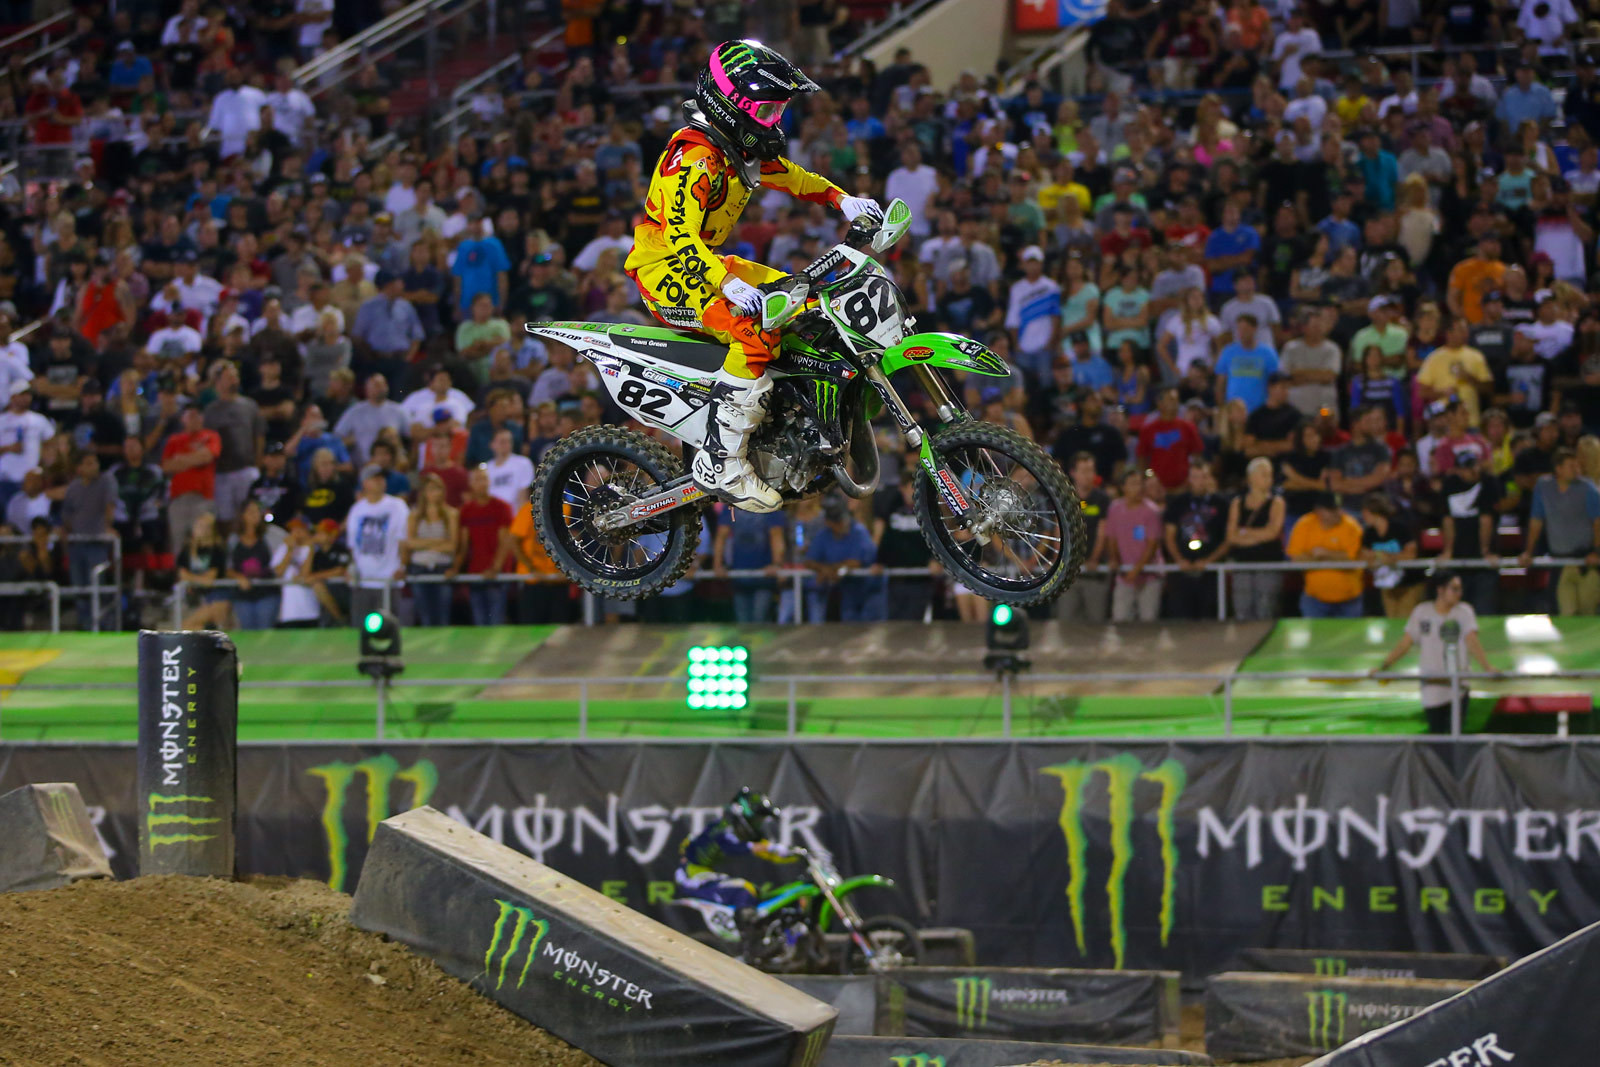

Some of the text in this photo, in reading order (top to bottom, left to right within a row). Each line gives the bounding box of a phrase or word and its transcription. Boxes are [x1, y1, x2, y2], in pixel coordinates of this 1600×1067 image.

[702, 89, 737, 127] MONSTER
[676, 243, 713, 286] FOX
[655, 273, 691, 308] FOX
[844, 278, 898, 337] 82
[539, 328, 582, 341] DUNLOP
[630, 338, 668, 348] Team Green
[741, 328, 755, 339] FOX
[585, 349, 623, 367] Kawasaki
[790, 353, 831, 372] MONSTER
[617, 379, 673, 420] 82
[681, 485, 697, 496] RK
[921, 457, 963, 516] DUNLOP
[938, 470, 969, 510] BRAKING
[158, 644, 183, 787] MONSTER
[187, 666, 198, 764] ENERGY
[446, 793, 827, 864] MONSTR
[1197, 794, 1600, 871] MONSTER
[1261, 885, 1559, 914] ENERGY
[543, 941, 653, 1010] MONSTER
[553, 970, 633, 1012] ENERGY
